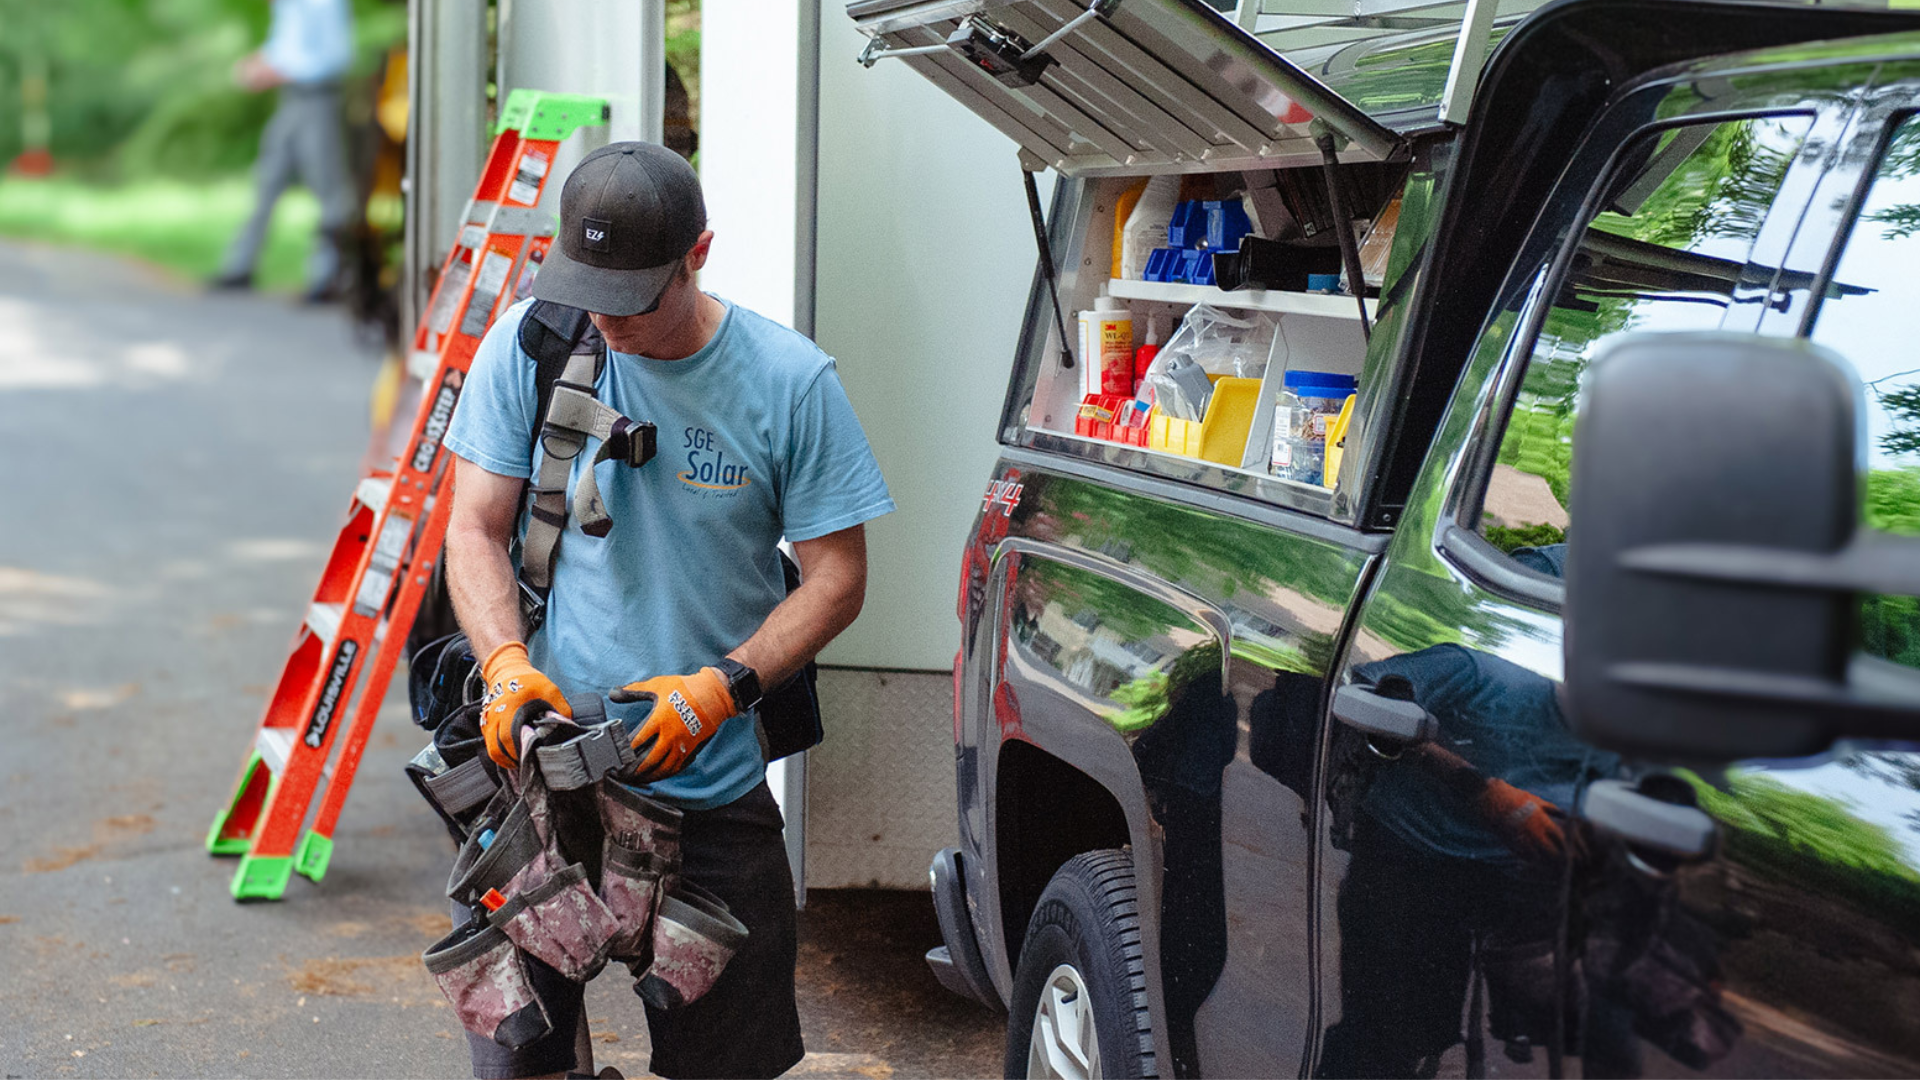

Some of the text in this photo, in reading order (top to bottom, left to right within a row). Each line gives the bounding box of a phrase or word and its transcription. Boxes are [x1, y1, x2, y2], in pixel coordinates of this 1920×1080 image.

[1104, 323, 1117, 331] 3M
[683, 427, 714, 452] SGE
[685, 450, 748, 486] Solar
[312, 641, 356, 735] LOUISVILLE
[669, 694, 698, 736] TOOLS
[671, 690, 701, 730] KLEIN
